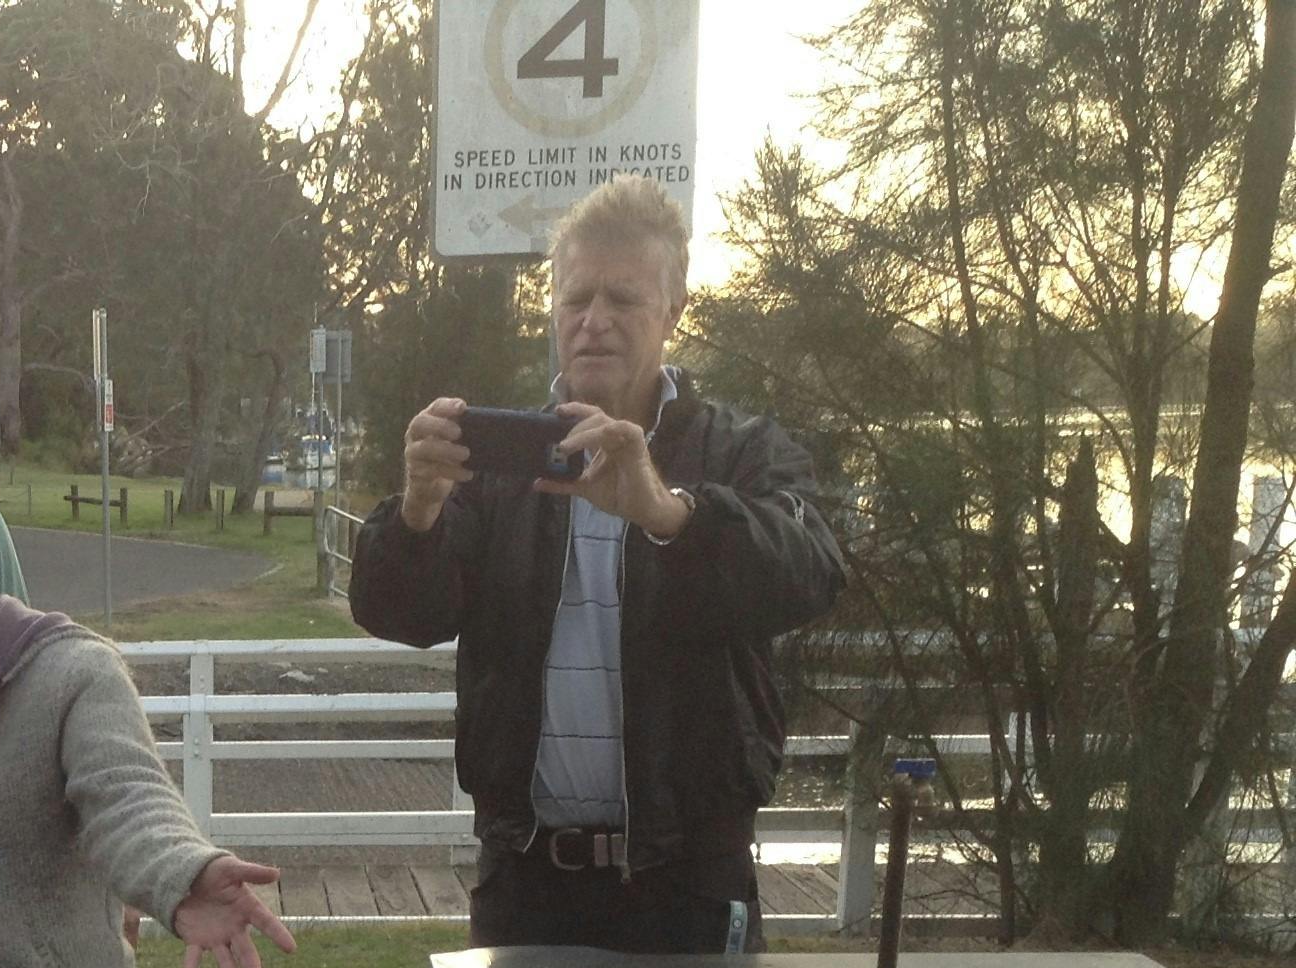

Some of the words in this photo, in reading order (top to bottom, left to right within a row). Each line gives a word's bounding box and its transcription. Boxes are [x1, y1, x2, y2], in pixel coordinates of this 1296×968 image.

[517, 0, 619, 98] 4
[454, 149, 515, 168] SPEED
[528, 147, 577, 165] LIMIT
[588, 146, 606, 163] IN
[619, 143, 682, 161] KNOTS
[444, 174, 462, 190] IN
[475, 170, 576, 189] DIRECTION
[589, 166, 690, 185] INDATED
